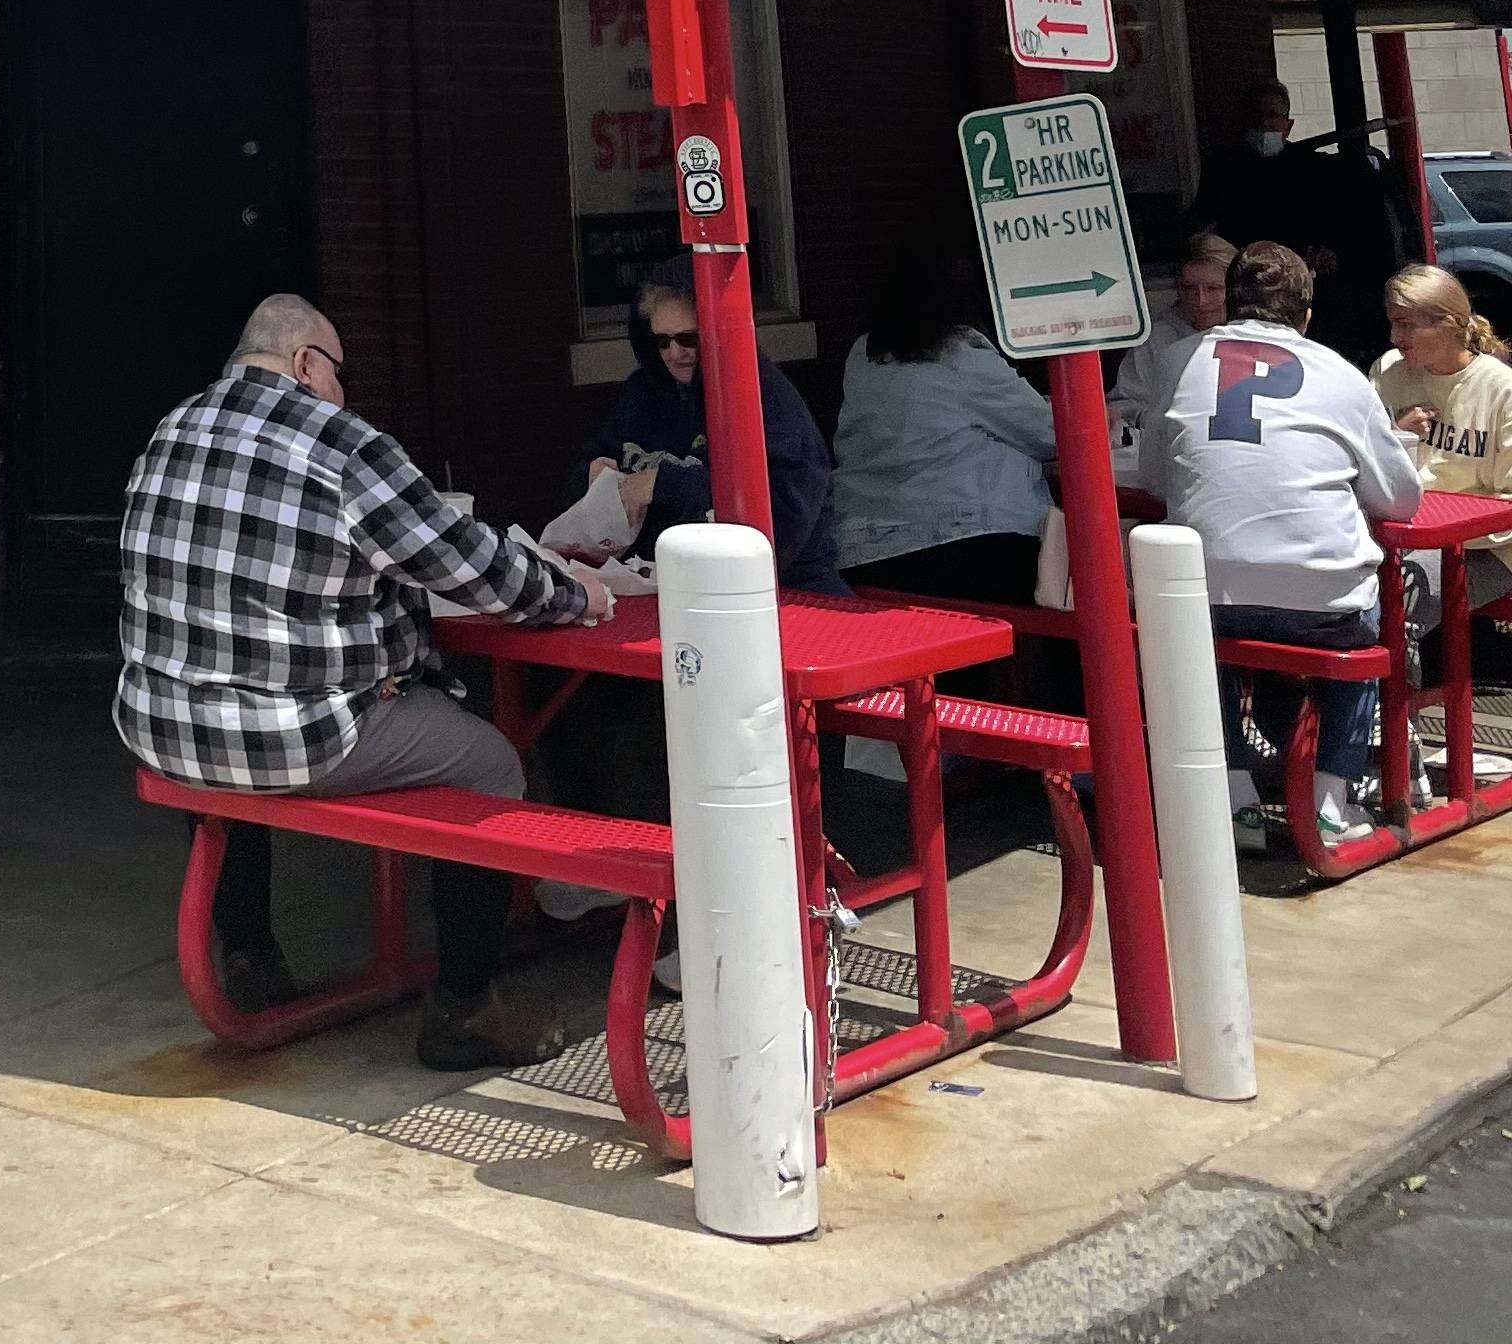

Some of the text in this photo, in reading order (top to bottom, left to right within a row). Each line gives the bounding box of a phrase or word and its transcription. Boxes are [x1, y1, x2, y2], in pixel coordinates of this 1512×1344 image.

[974, 129, 1005, 189] 2
[1035, 114, 1074, 147] HR
[1015, 147, 1106, 189] PARKING
[992, 205, 1113, 245] MON-SUN
[1208, 339, 1305, 445] P
